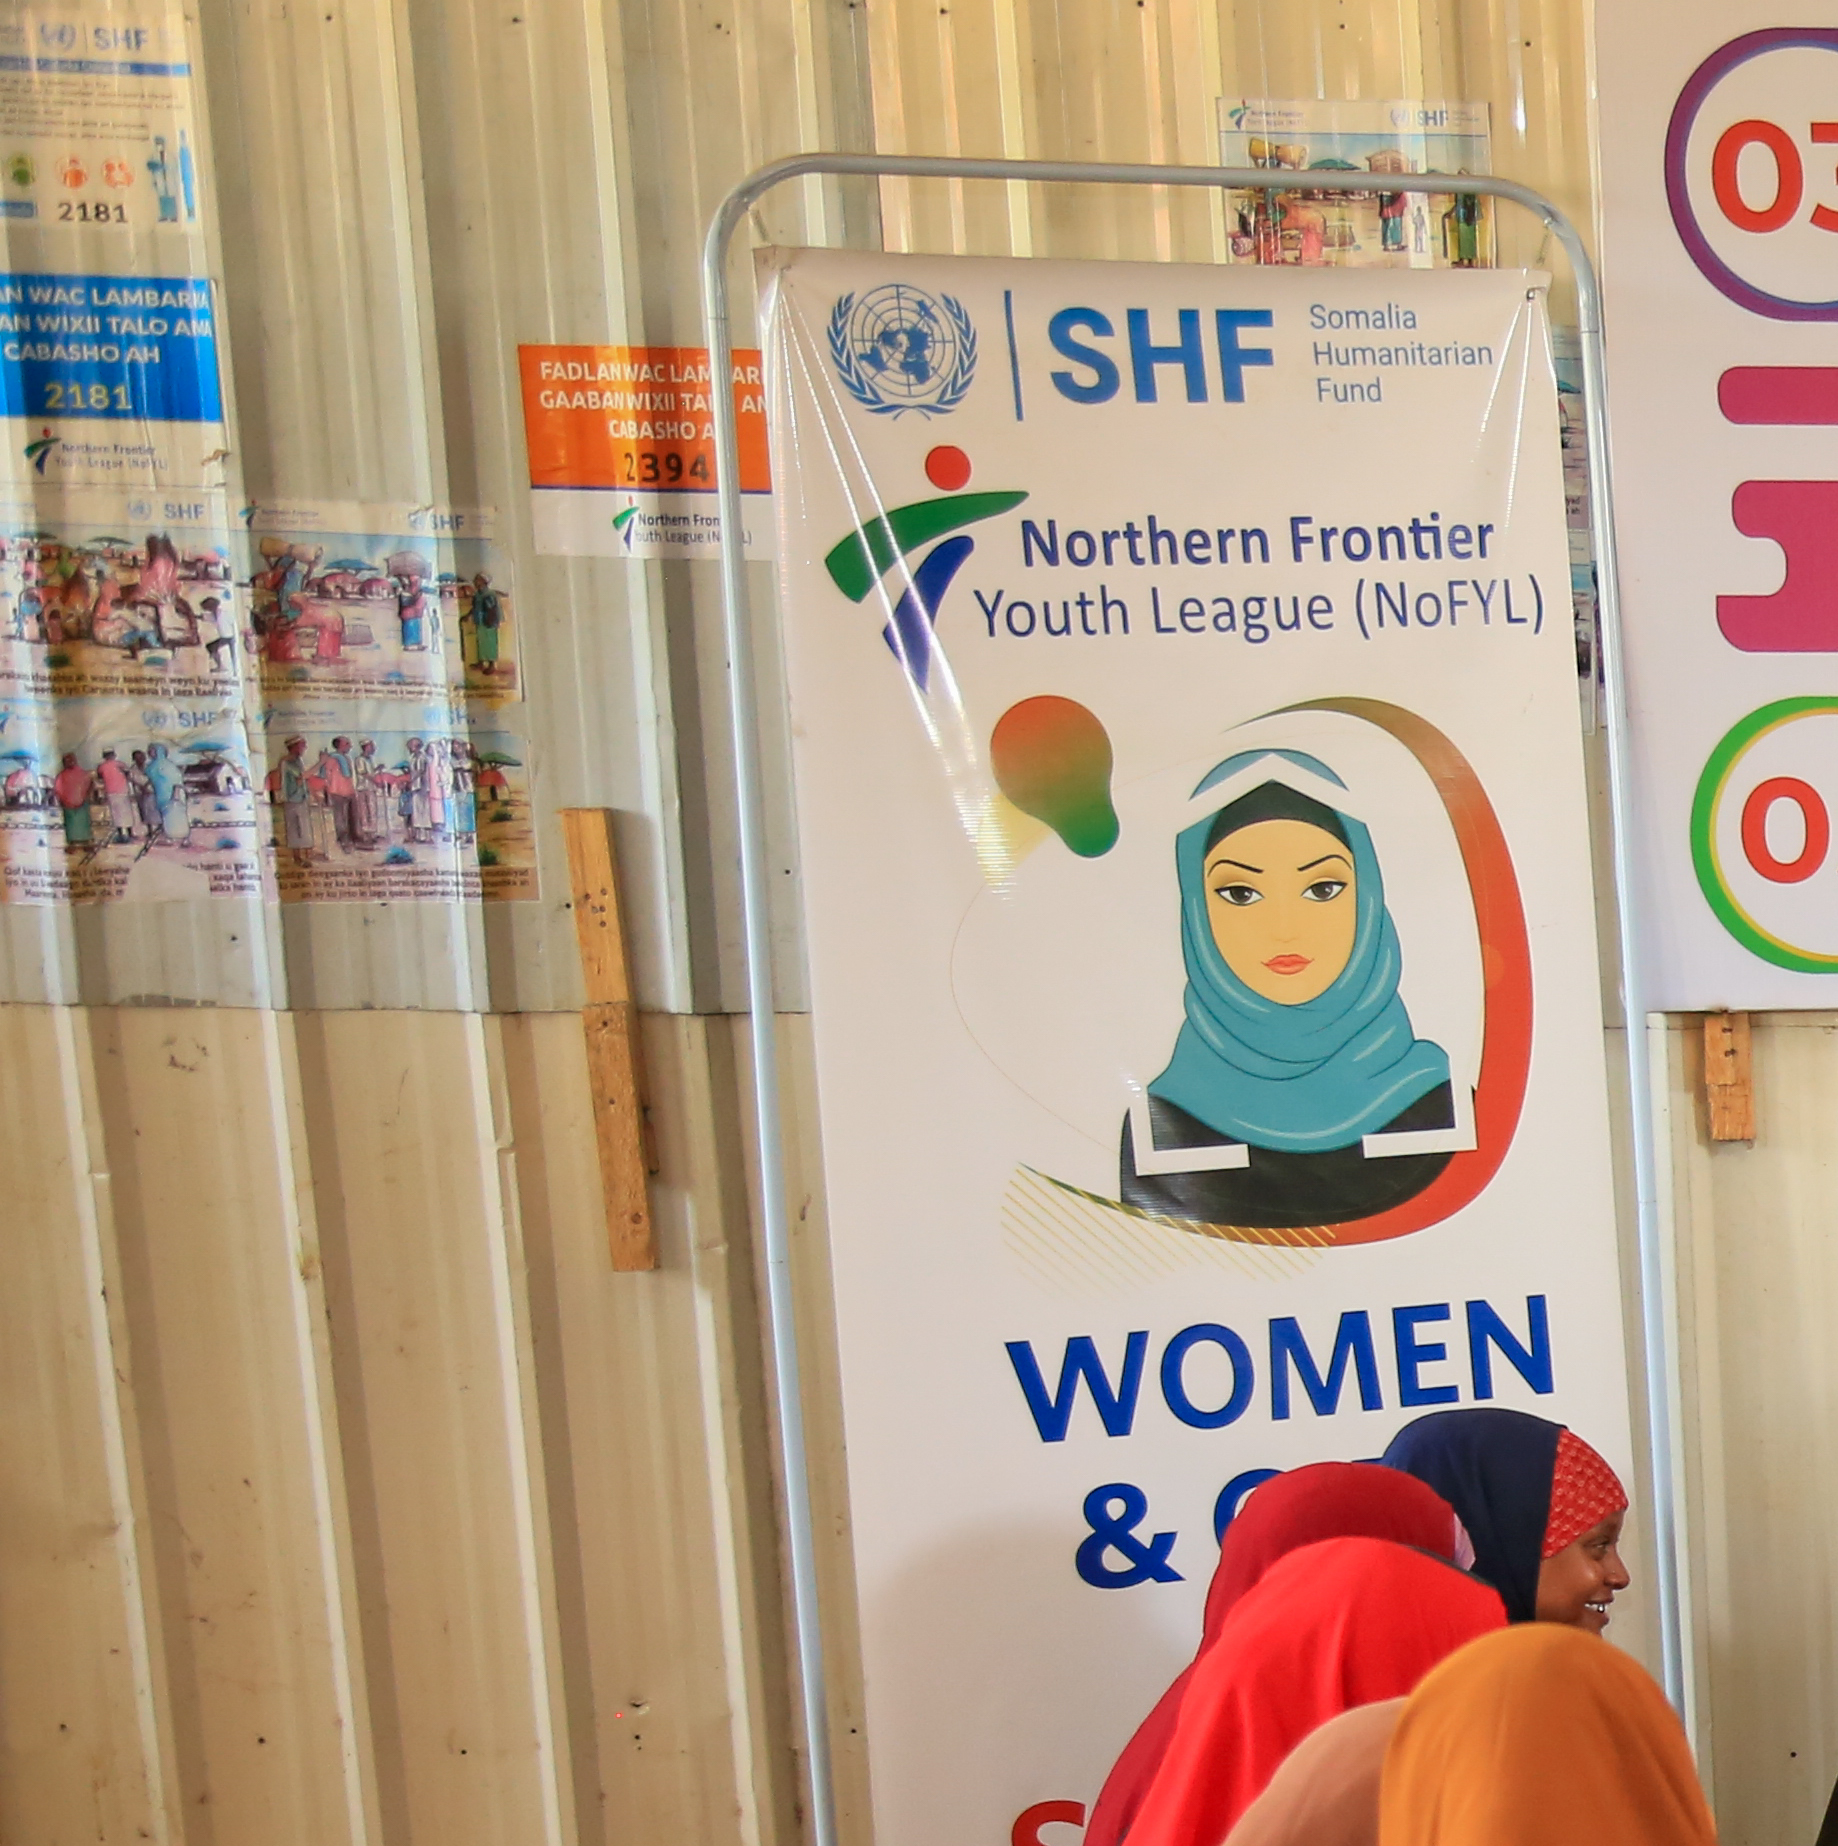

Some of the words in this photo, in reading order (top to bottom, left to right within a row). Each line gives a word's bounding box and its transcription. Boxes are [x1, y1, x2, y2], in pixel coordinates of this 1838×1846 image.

[58, 202, 128, 223] 2181
[28, 286, 85, 305] WAC
[36, 314, 100, 334] WIXII
[107, 317, 168, 336] TALO
[1309, 303, 1418, 331] Somalia
[4, 343, 120, 363] CABASHO
[125, 345, 160, 363] AH
[1048, 307, 1275, 404] SHF
[1313, 340, 1493, 368] Humanitarian
[540, 362, 622, 382] FADLAN
[622, 364, 665, 382] WAC
[44, 382, 132, 411] 2181
[540, 390, 623, 410] GAABAN
[623, 393, 675, 411] WIXII
[1317, 376, 1383, 404] Fund
[609, 419, 697, 441] CABASHO
[624, 452, 709, 482] 2394
[163, 503, 205, 519] SHF
[638, 513, 689, 526] Northern
[666, 531, 703, 545] League
[1021, 516, 1270, 568] Northern
[1291, 513, 1495, 562] Frontier
[973, 584, 1131, 640] Youth
[1152, 583, 1335, 645] League
[1355, 575, 1545, 641] (NoFYL)
[1005, 1294, 1555, 1444] WOMEN
[1076, 1482, 1186, 1589] &
